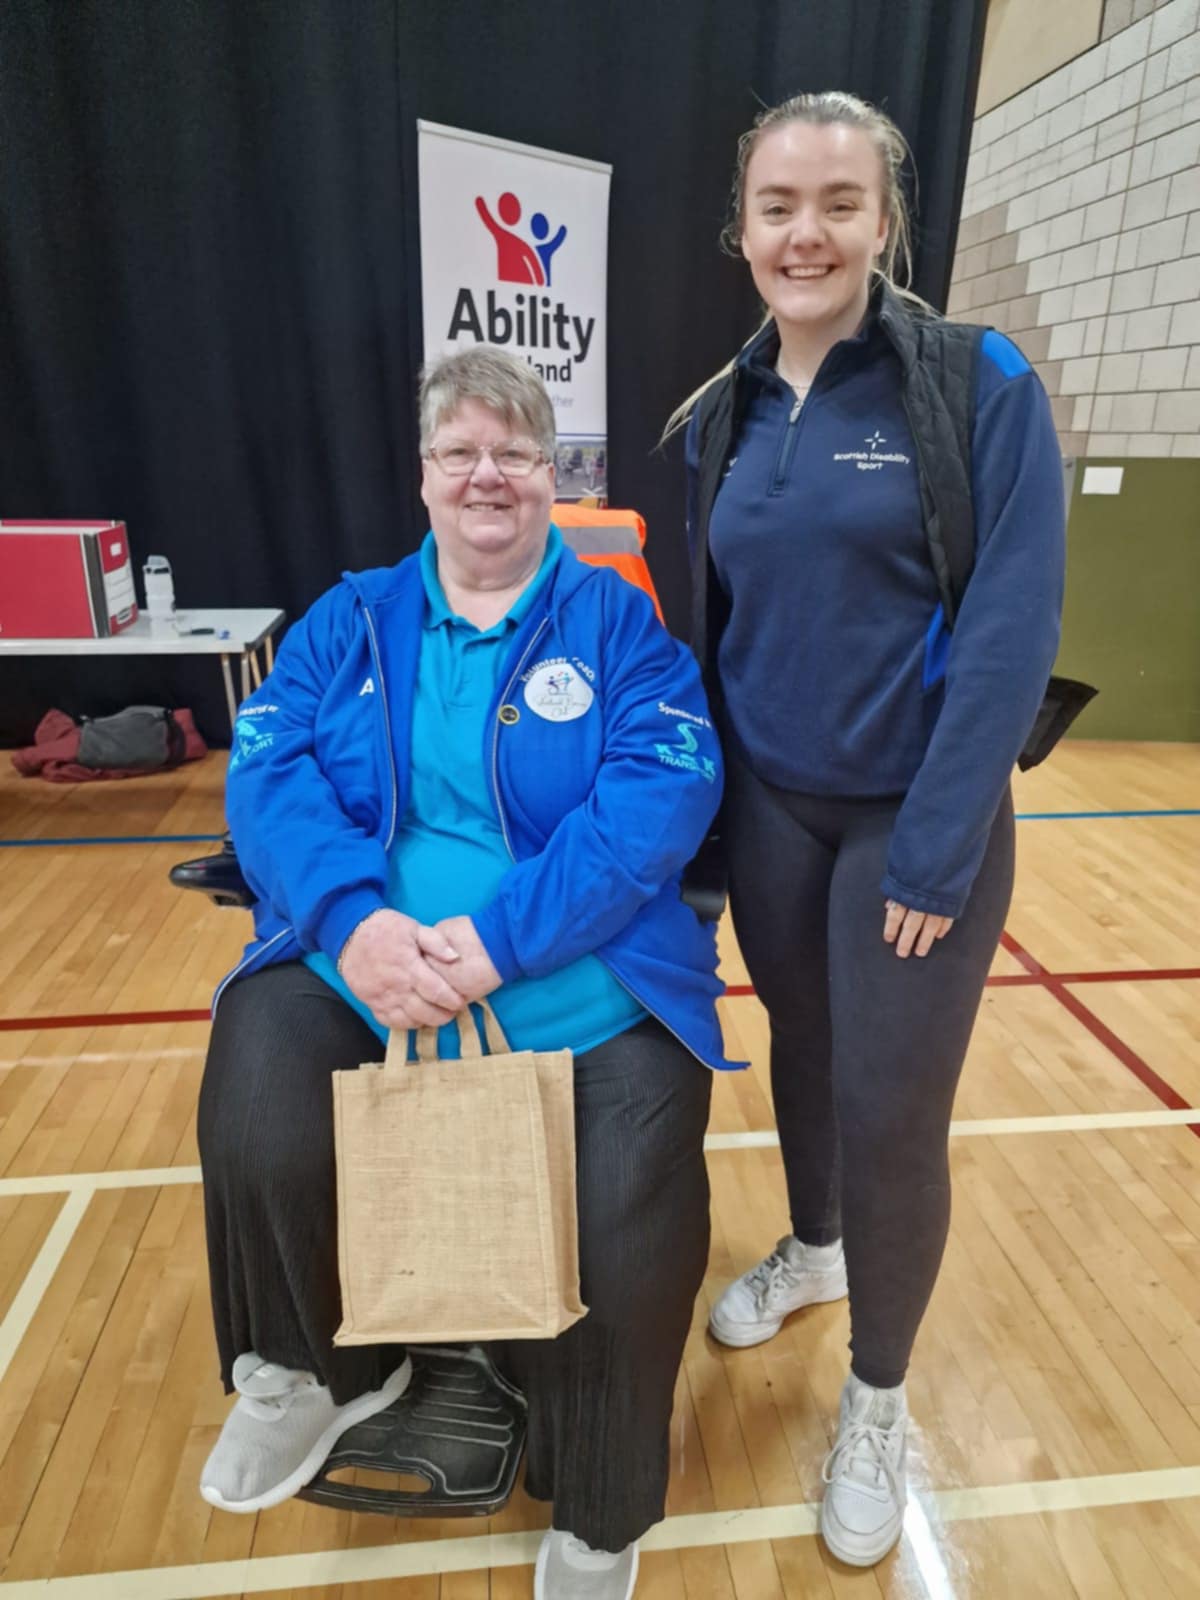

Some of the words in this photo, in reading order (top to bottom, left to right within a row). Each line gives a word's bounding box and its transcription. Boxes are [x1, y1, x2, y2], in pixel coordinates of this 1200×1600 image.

[447, 288, 595, 363] Ability
[857, 461, 883, 470] Sport
[358, 677, 375, 697] A
